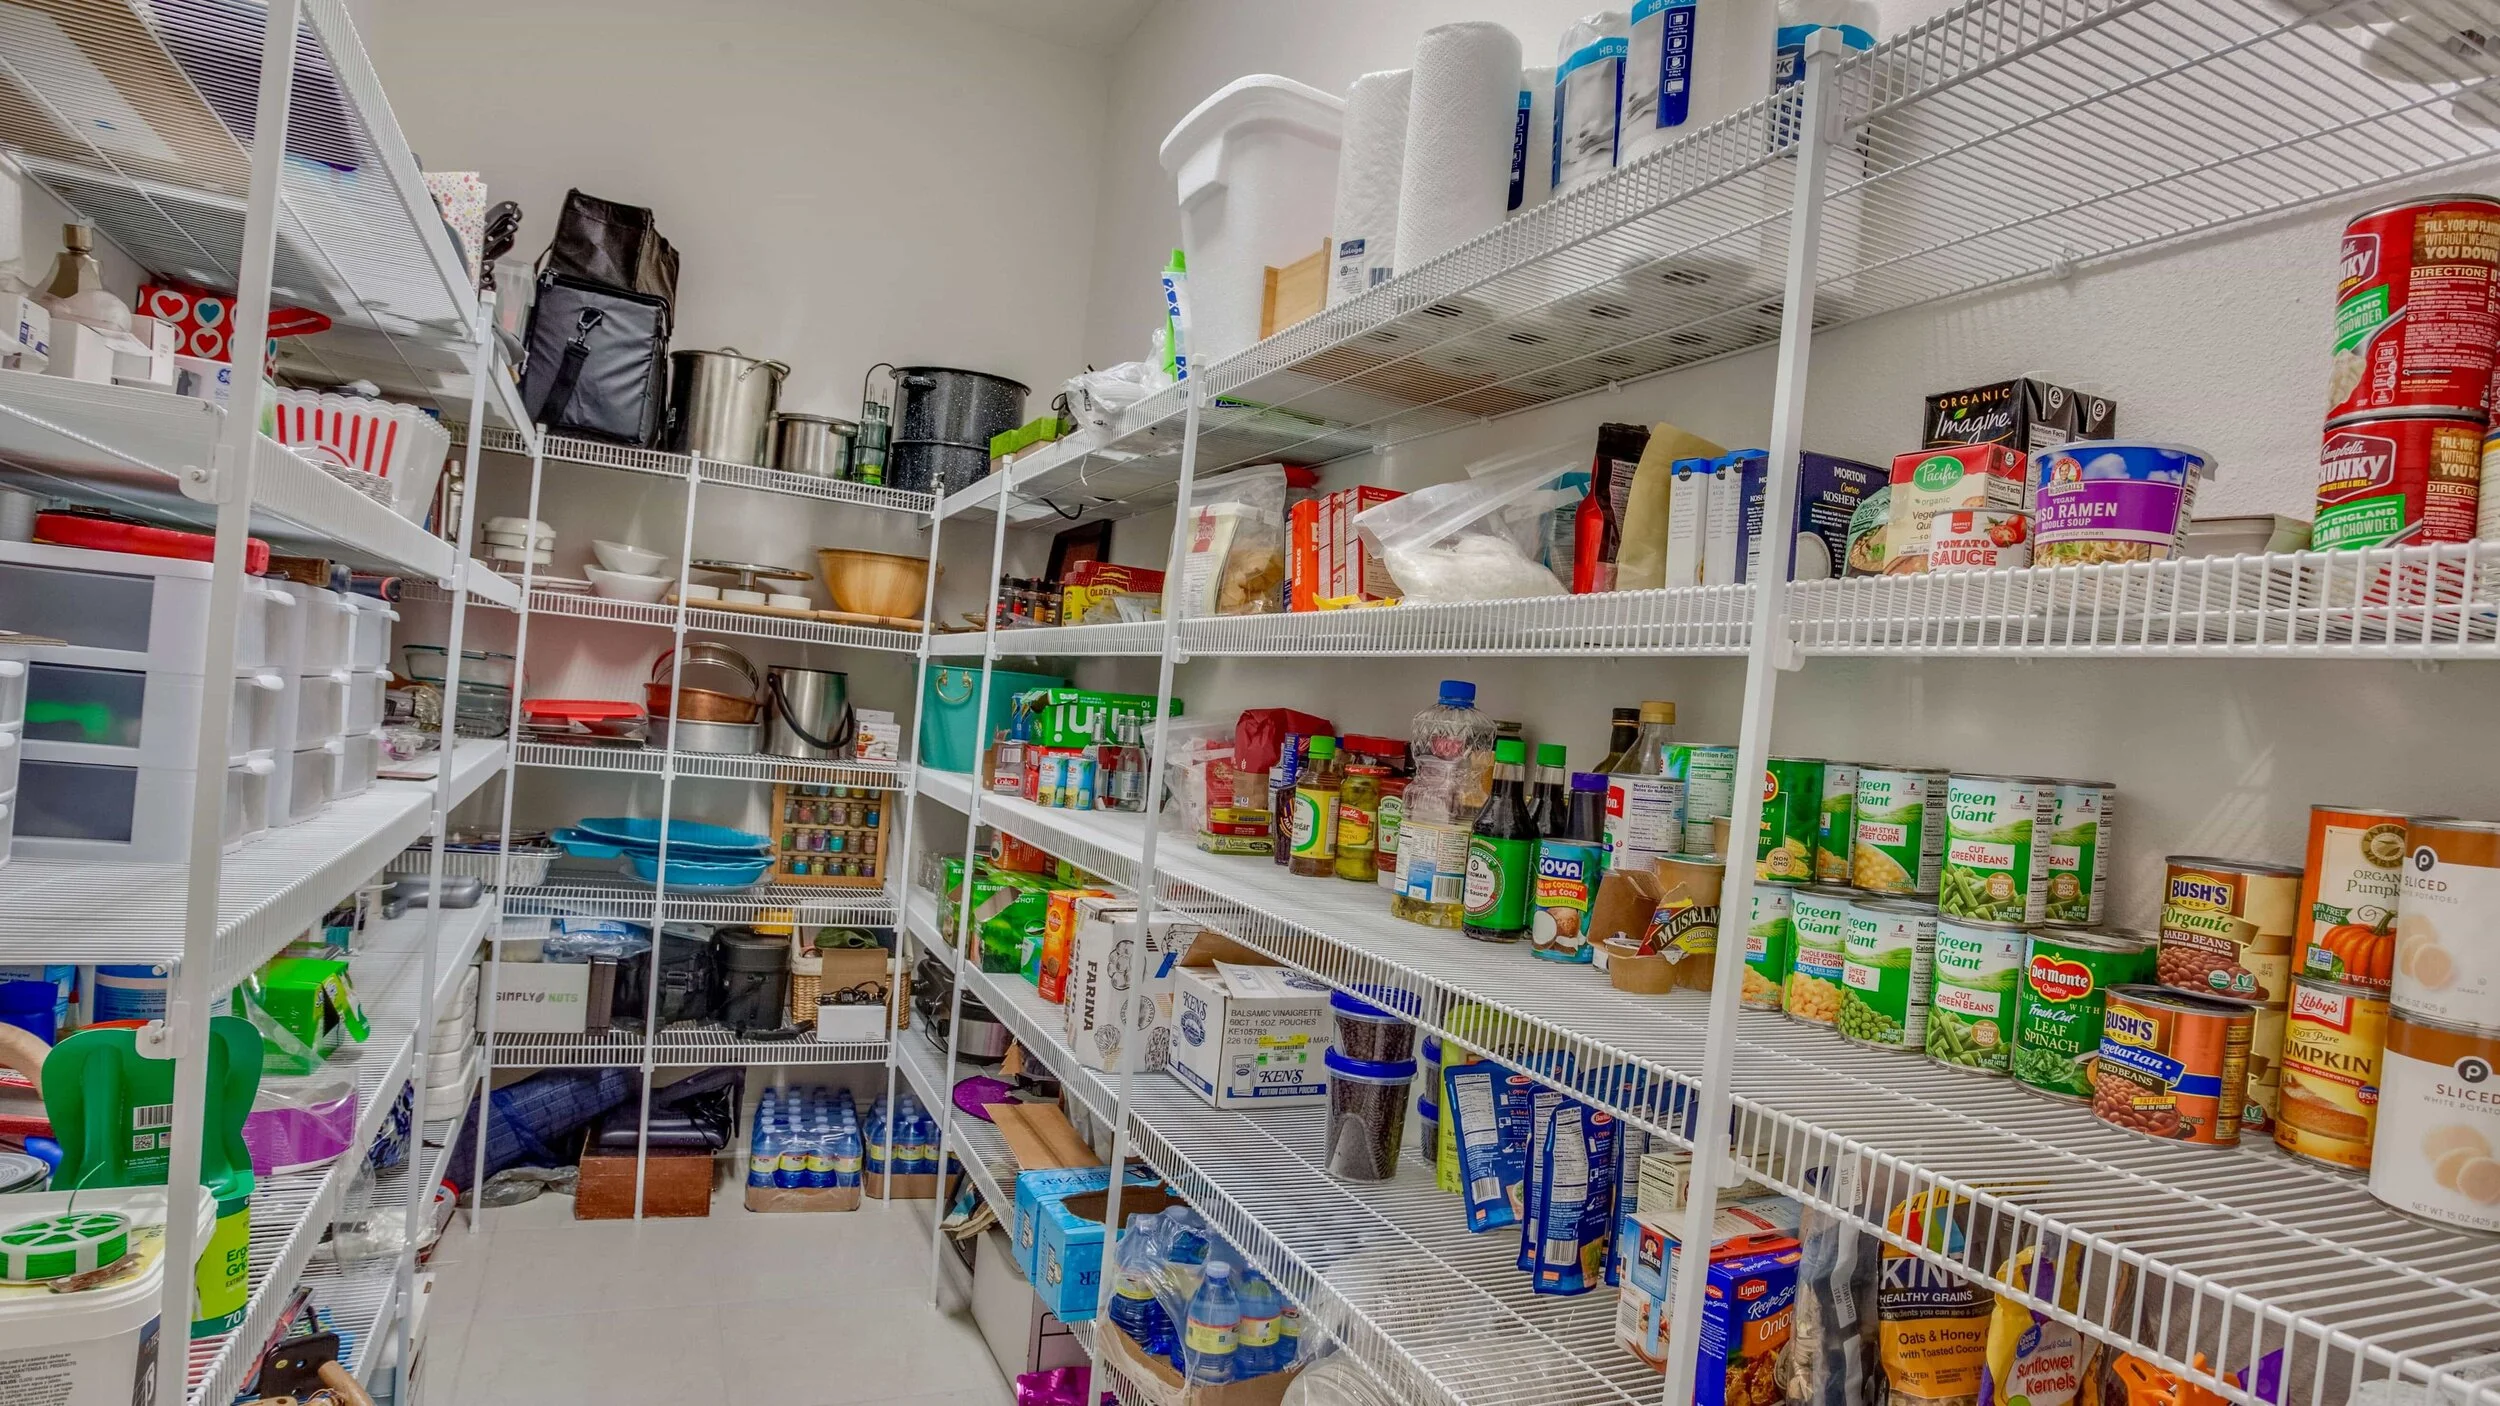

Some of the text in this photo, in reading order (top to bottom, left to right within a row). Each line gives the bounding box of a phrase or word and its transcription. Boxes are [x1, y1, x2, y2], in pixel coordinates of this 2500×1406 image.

[1600, 46, 1612, 56] HB
[2426, 233, 2468, 246] WITHOUT
[2425, 247, 2498, 263] YOU DOWN
[2411, 267, 2488, 279] DIRECTIONS
[1940, 388, 2010, 408] ORGANIC
[1834, 466, 1866, 484] MORTON
[2319, 455, 2388, 482] HUNKY
[2441, 463, 2468, 476] YOU
[1988, 481, 2022, 496] Nutrition Facts
[2428, 484, 2478, 498] DIRECTIO
[1824, 490, 1855, 506] KOSHER
[1922, 496, 1950, 506] organic
[2052, 496, 2076, 504] VEGAN
[2058, 502, 2118, 518] RAMEN
[2332, 508, 2396, 524] ENGLAND
[2042, 518, 2092, 530] NOODLE SOUP
[2314, 516, 2398, 546] CLAM CHOWDER
[1936, 540, 1990, 550] TOMATO
[1931, 549, 1998, 566] SAUCE
[1090, 588, 1103, 597] OLD
[1720, 752, 1734, 760] Facts
[1950, 788, 1996, 806] Green
[1951, 805, 1996, 824] Giant
[1860, 824, 1900, 835] CREAM STYLE
[1859, 832, 1900, 843] SWEET CORN
[1968, 846, 1986, 854] CUT
[1951, 851, 2008, 866] GREEN BEANS
[2050, 856, 2074, 866] EANS
[1540, 858, 1582, 878] GOYA
[2354, 870, 2402, 883] ORGAN
[2405, 876, 2448, 892] SLICED
[1553, 882, 1584, 892] COCONUT
[1559, 889, 1578, 898] COCO
[2172, 880, 2228, 906] BUSH'S
[2346, 879, 2400, 898] Pumpk
[2182, 900, 2208, 908] BEST
[2416, 892, 2458, 905] POTATOES
[1796, 903, 1842, 922] Green
[2326, 906, 2346, 917] FREE
[1798, 918, 1842, 936] Giant
[1848, 912, 1877, 933] reen
[2166, 906, 2234, 934] Organic
[1937, 931, 1983, 954] Green
[2164, 929, 2232, 951] BAKED BEANS
[1746, 944, 1762, 952] ORN
[1802, 949, 1844, 961] WHOLE KERNEL
[1800, 956, 1844, 968] SWEET CORN
[1938, 949, 1983, 971] Giant
[1798, 964, 1814, 974] 50%
[2032, 964, 2088, 988] Del Monte
[2332, 972, 2348, 981] NET
[1848, 974, 1866, 986] PEAS
[496, 992, 578, 1002] SIMPLY NUTS
[1084, 960, 1098, 1031] FARINA
[1955, 990, 1972, 1001] CUT
[2042, 984, 2066, 996] Quality
[1183, 990, 1208, 1021] KEN'S
[1938, 994, 1994, 1013] GREEN BEANS
[2300, 989, 2338, 1014] Libby's
[1231, 1008, 1322, 1017] BALSAMIC VINAIGRETTE
[2029, 1004, 2052, 1018] Fresh
[2070, 1004, 2100, 1015] WITH
[1280, 1018, 1316, 1026] POUCHES
[2034, 1017, 2066, 1037] LEAF
[2106, 1010, 2153, 1041] BUSH'S
[1228, 1028, 1267, 1036] KE1057B3
[1978, 1030, 1994, 1038] NON
[2112, 1032, 2134, 1042] BEST
[2312, 1031, 2340, 1044] Pure
[1313, 1036, 1328, 1044] MAR
[2025, 1028, 2080, 1054] SPINACH
[2285, 1037, 2372, 1076] UMPKIN
[1259, 1069, 1304, 1084] KEN'S
[2118, 1068, 2153, 1086] BEANS
[2312, 1067, 2360, 1086] PRESERVATIVES
[1259, 1086, 1318, 1096] PORTION CONTROL POUCHES
[2358, 1092, 2378, 1101] USA
[2436, 1084, 2500, 1105] SLICED
[2424, 1094, 2500, 1116] WHITE POTATO
[1642, 1160, 1675, 1178] Nutrition Facts
[2412, 1202, 2471, 1222] NET WT 15 OZ
[1640, 1250, 1662, 1266] QUAKER
[1741, 1284, 1765, 1296] Lipton
[1880, 1290, 1973, 1303] HEALTHY GRAINS
[1748, 1296, 1780, 1320] Recipe
[224, 1310, 242, 1328] 70
[1899, 1330, 1982, 1344] Oats & Honey
[1900, 1344, 1984, 1359] with Toasted Cocon
[2017, 1354, 2074, 1380] Sunflower
[2026, 1372, 2076, 1397] Kernels
